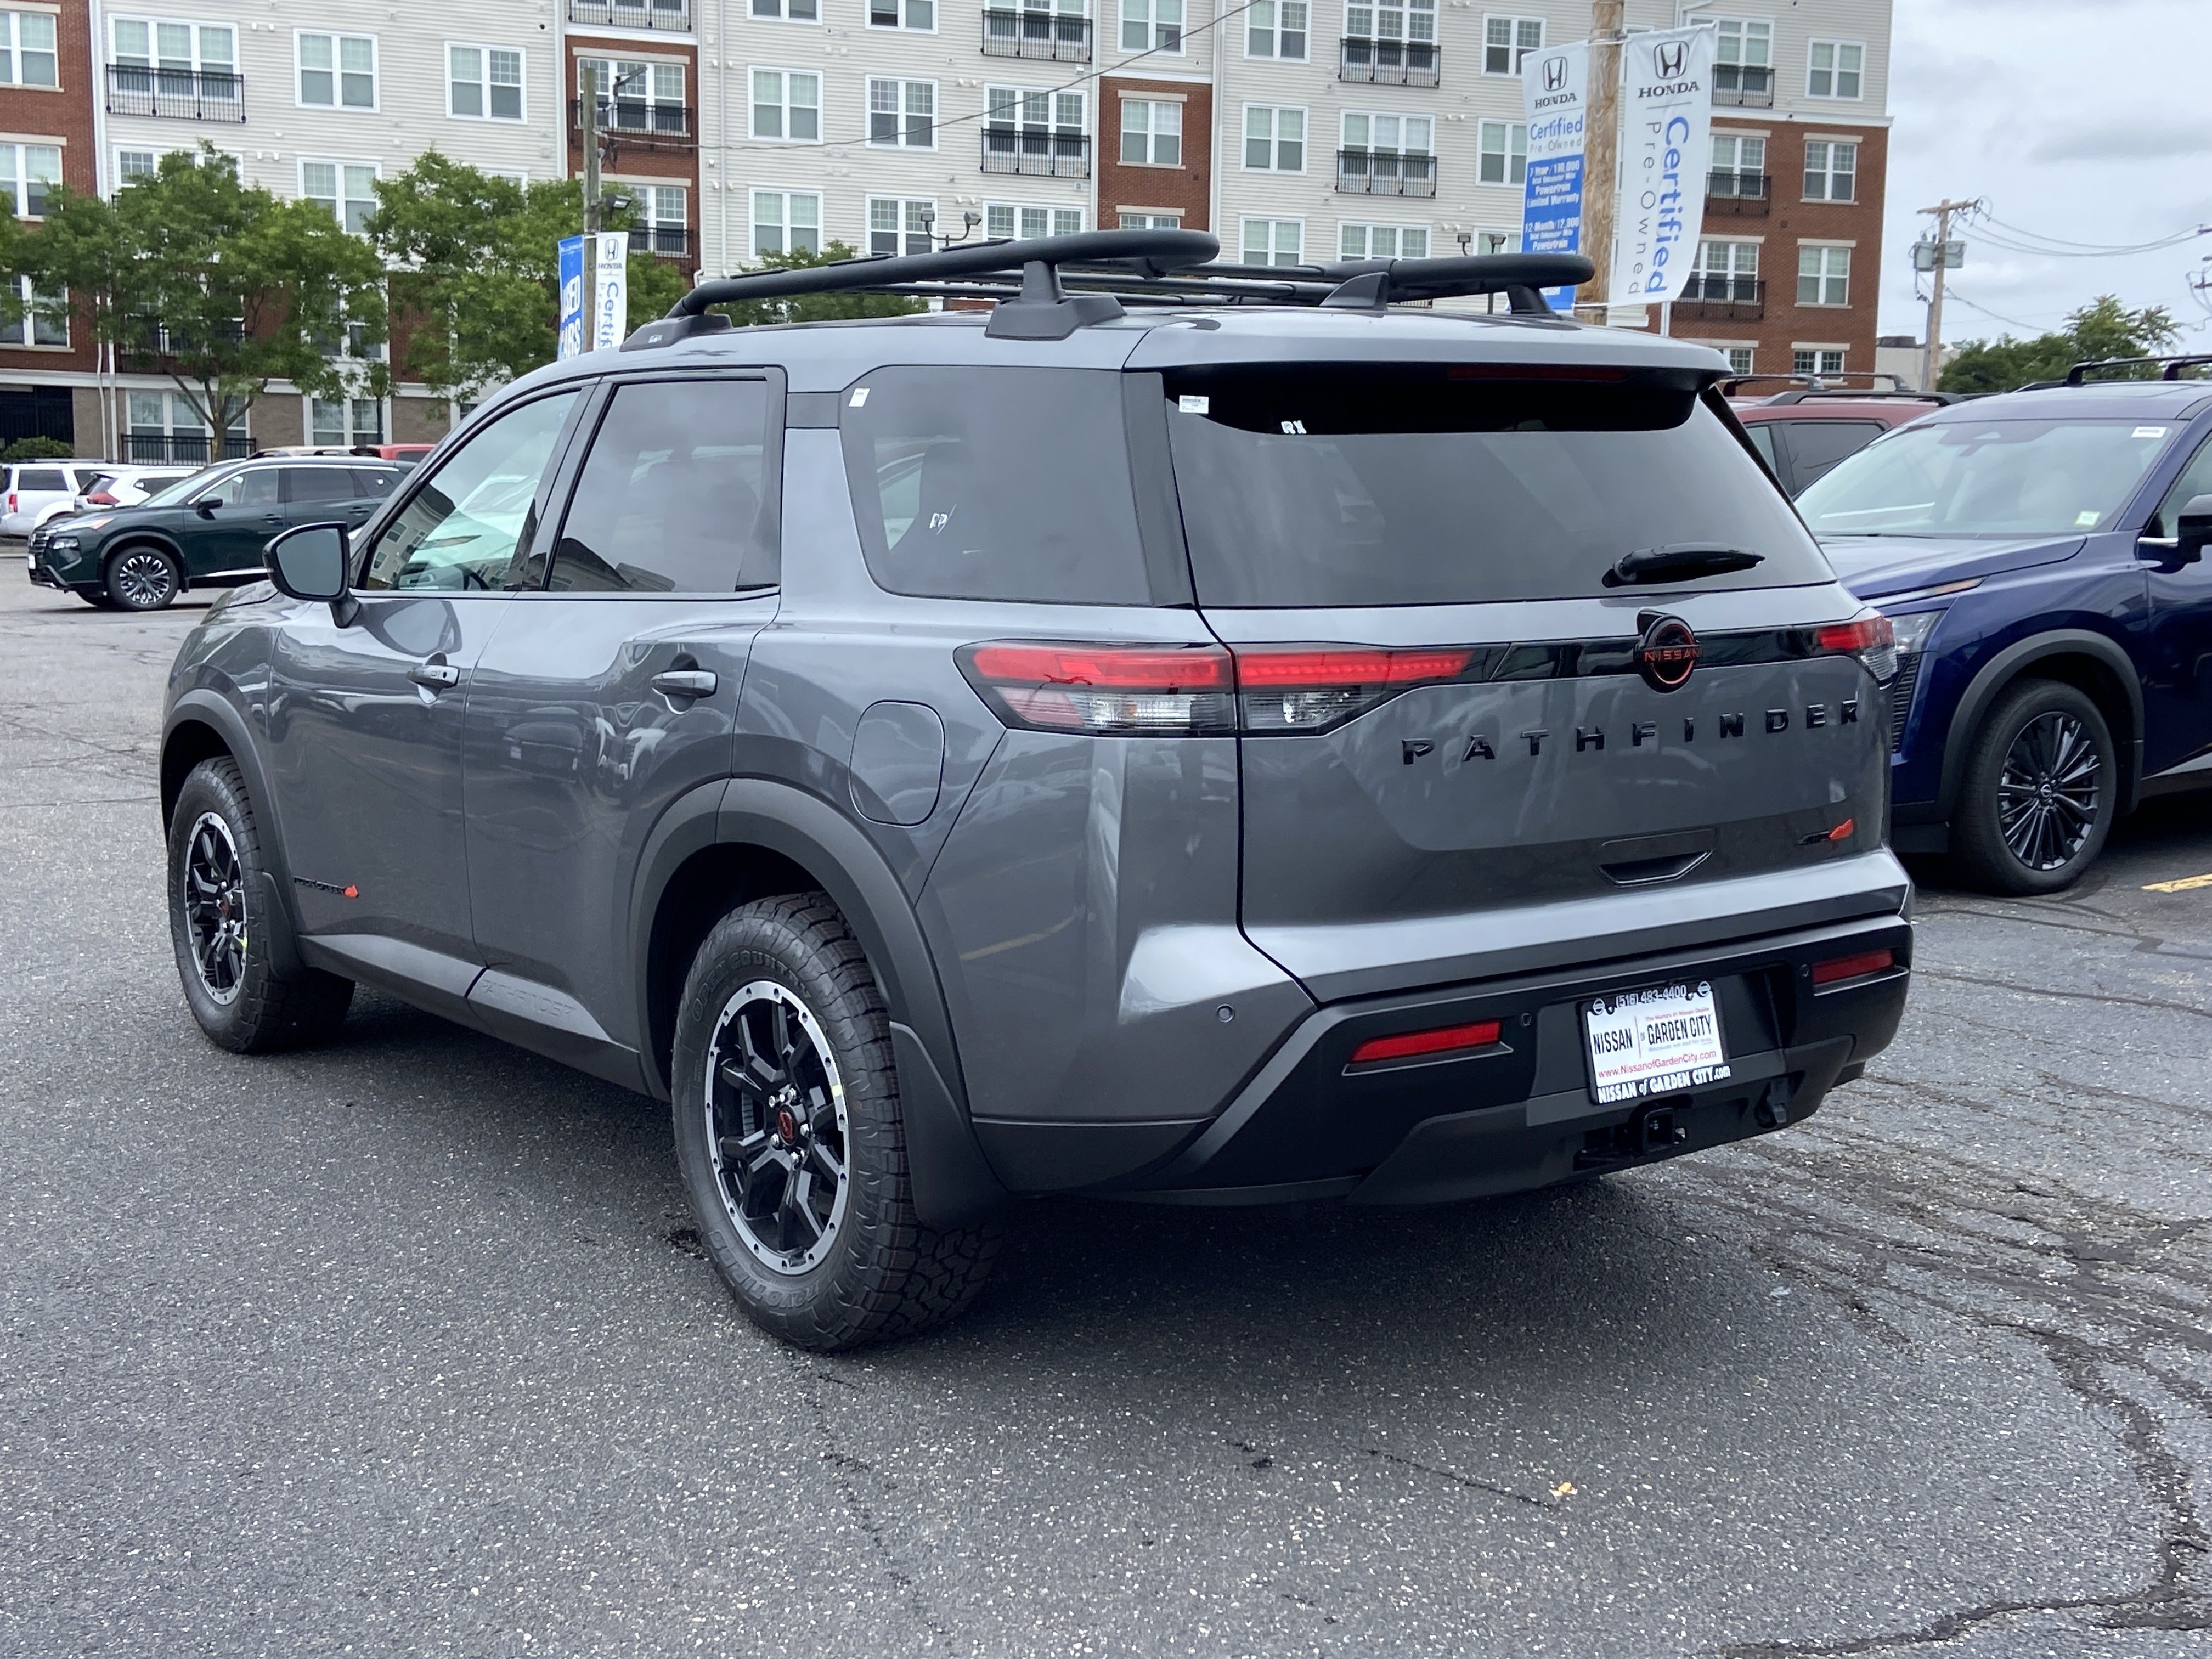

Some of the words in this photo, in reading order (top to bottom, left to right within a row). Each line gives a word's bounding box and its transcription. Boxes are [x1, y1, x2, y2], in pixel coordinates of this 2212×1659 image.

[1534, 93, 1577, 109] HONDA
[1638, 81, 1700, 98] HONDA
[1530, 114, 1583, 140] Certified
[1628, 122, 1661, 294] Pre-Owned
[1645, 116, 1689, 294] Certified
[1645, 648, 1701, 662] NISSAN
[1401, 698, 1859, 766] PATHFINDER
[1593, 1028, 1633, 1055] NISSAN
[1647, 1018, 1688, 1045] GARDEN
[1689, 1013, 1712, 1037] CITY
[1597, 1081, 1638, 1104] NISSAN
[1649, 1070, 1691, 1093] GARDEN
